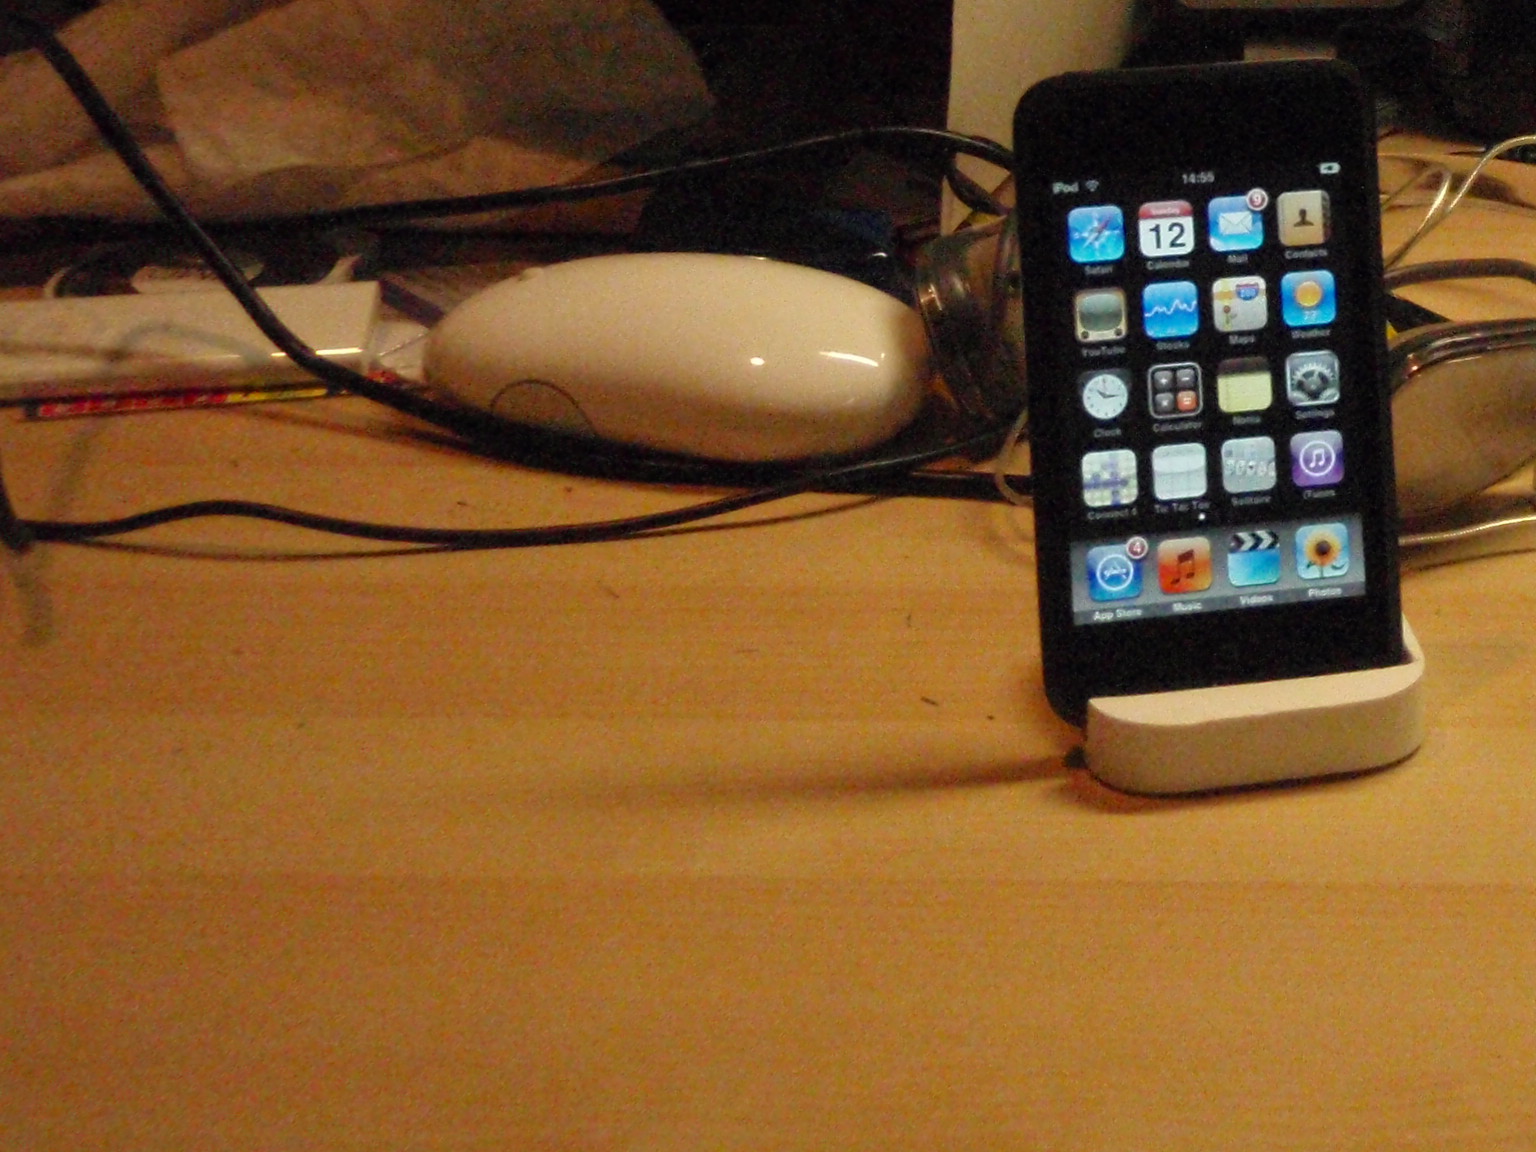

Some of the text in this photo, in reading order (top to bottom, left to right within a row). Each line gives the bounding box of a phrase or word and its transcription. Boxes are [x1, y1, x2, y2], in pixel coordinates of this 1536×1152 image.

[1053, 182, 1079, 194] iPod
[1149, 222, 1186, 250] 12
[1285, 249, 1328, 260] Contacts
[1146, 259, 1190, 270] Calendar
[1229, 334, 1255, 345] Maps
[1295, 408, 1335, 420] Settings
[1232, 415, 1260, 426] Notes
[1152, 421, 1201, 433] Calculator
[1093, 428, 1122, 439] Clock
[1087, 509, 1129, 521] Connect
[1308, 586, 1342, 598] Photos
[1239, 594, 1274, 605] Videos
[1172, 601, 1202, 613] Music
[1093, 608, 1142, 622] App Store
